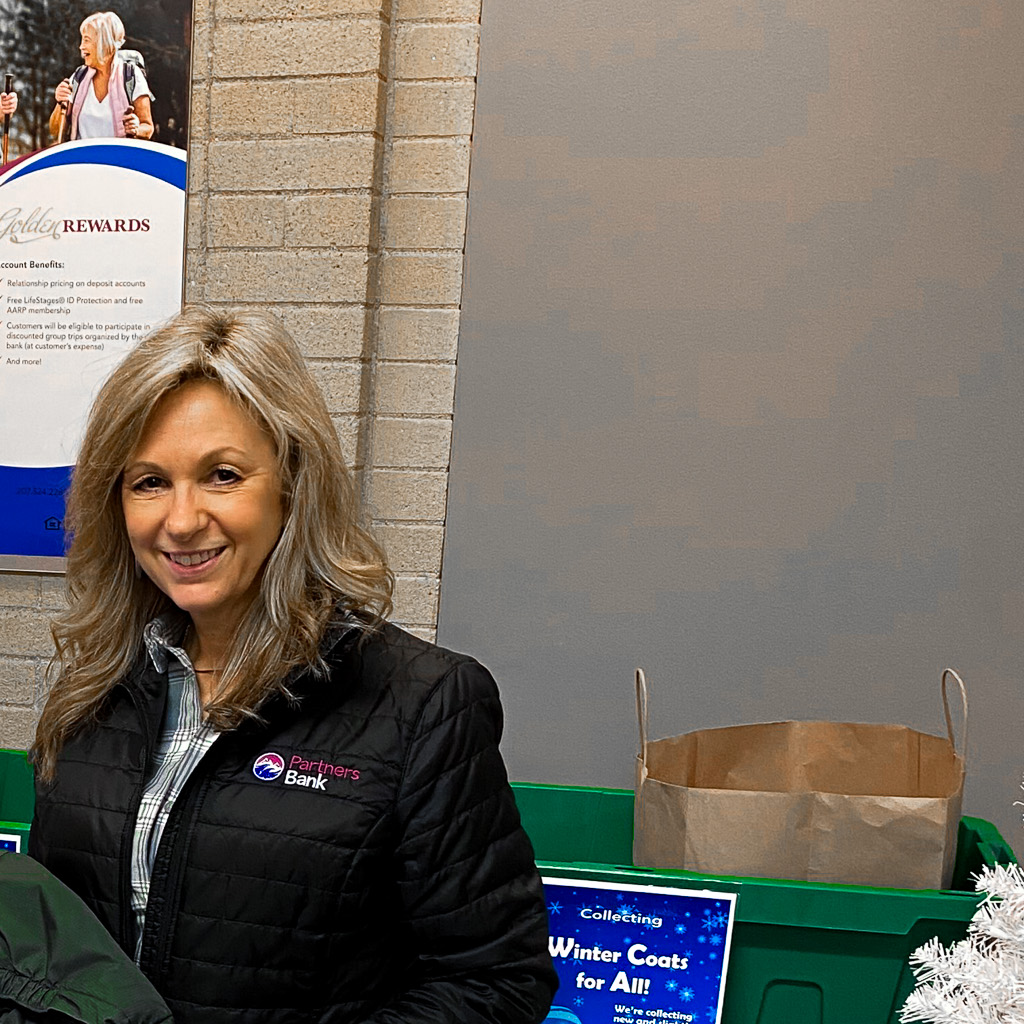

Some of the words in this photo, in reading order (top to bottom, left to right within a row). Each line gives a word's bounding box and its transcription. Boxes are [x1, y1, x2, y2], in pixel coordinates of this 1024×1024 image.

[63, 219, 150, 233] REWARDS
[30, 260, 64, 268] Benefits:
[50, 280, 74, 288] pricing
[87, 280, 113, 288] deposit
[68, 323, 94, 332] eligible
[289, 755, 360, 780] Partners
[284, 770, 328, 790] Bank
[580, 908, 662, 928] Collecting
[548, 936, 621, 963] Winter
[628, 943, 689, 970] Coats
[576, 972, 605, 990] for
[610, 971, 650, 994] All!
[615, 1004, 644, 1015] We're
[646, 1009, 693, 1022] collecting
